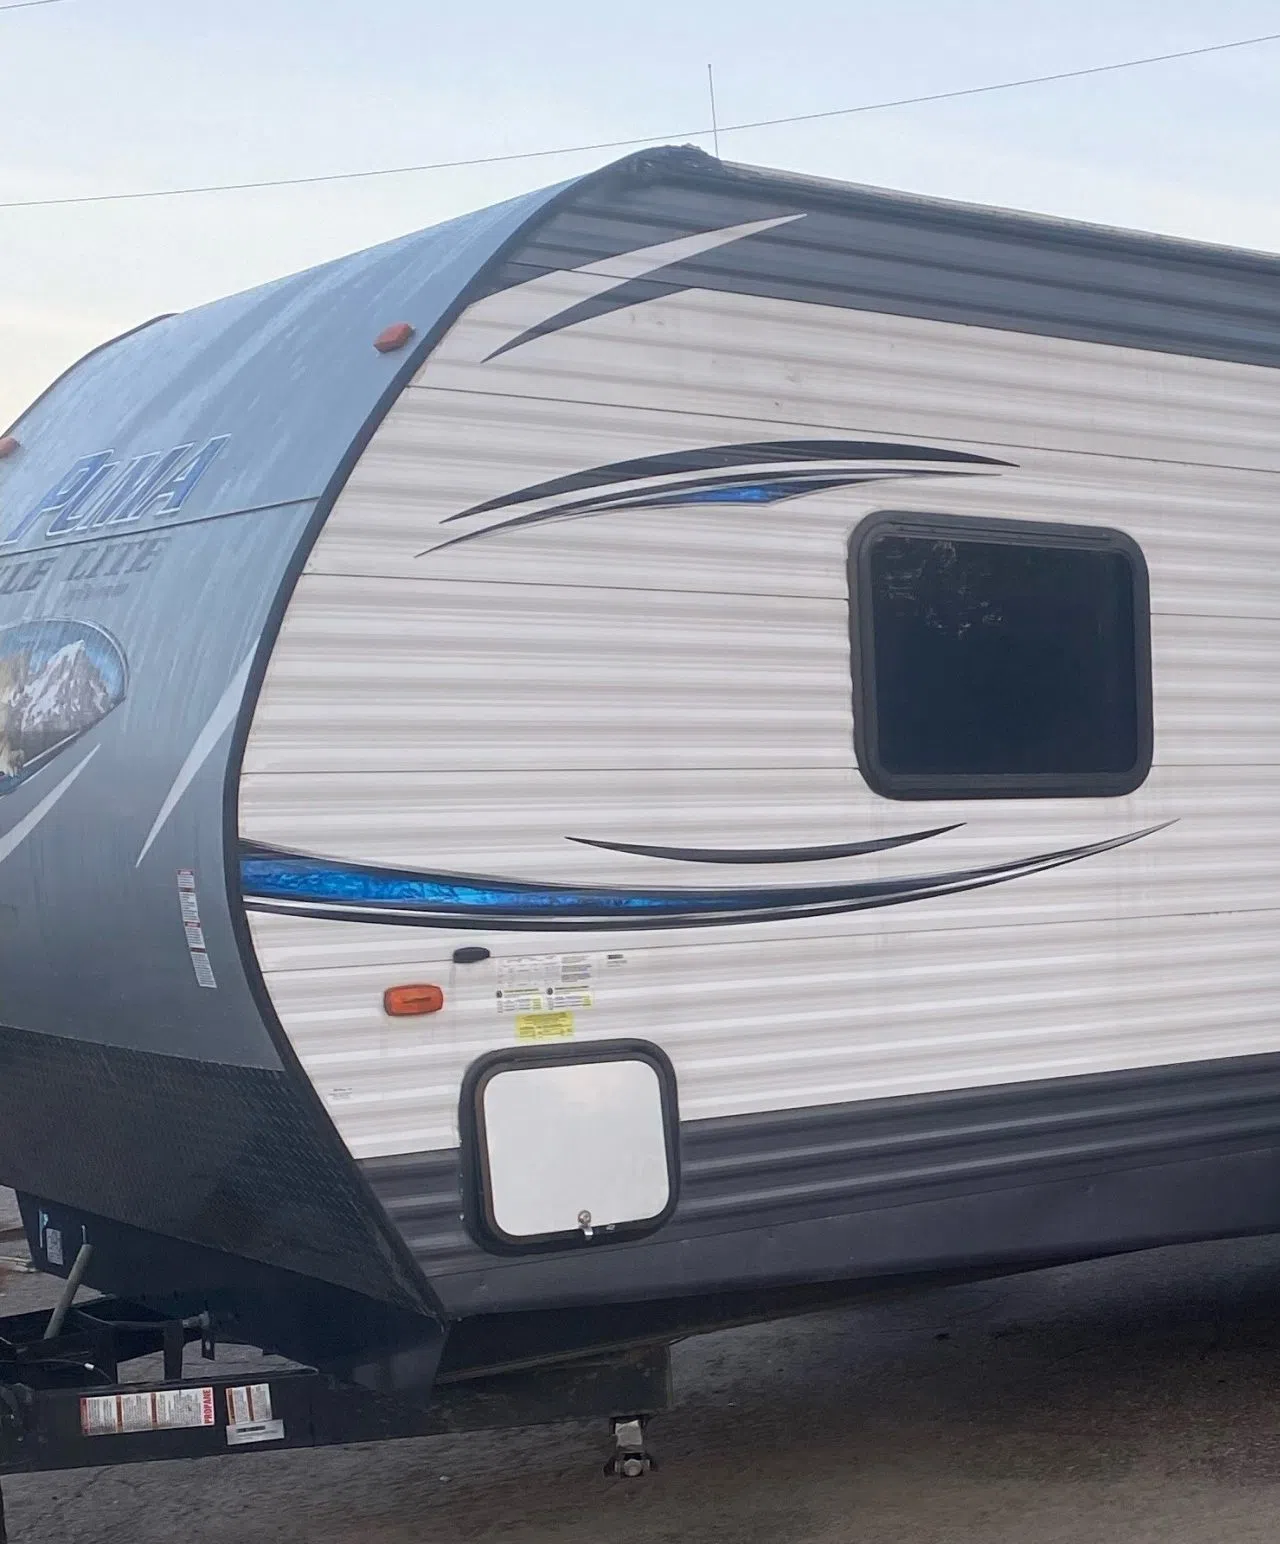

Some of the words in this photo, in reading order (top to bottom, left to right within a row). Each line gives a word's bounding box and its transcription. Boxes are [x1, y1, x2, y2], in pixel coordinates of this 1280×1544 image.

[0, 433, 232, 546] PUMA
[61, 536, 173, 581] LITE
[203, 1389, 213, 1425] PROPANE
